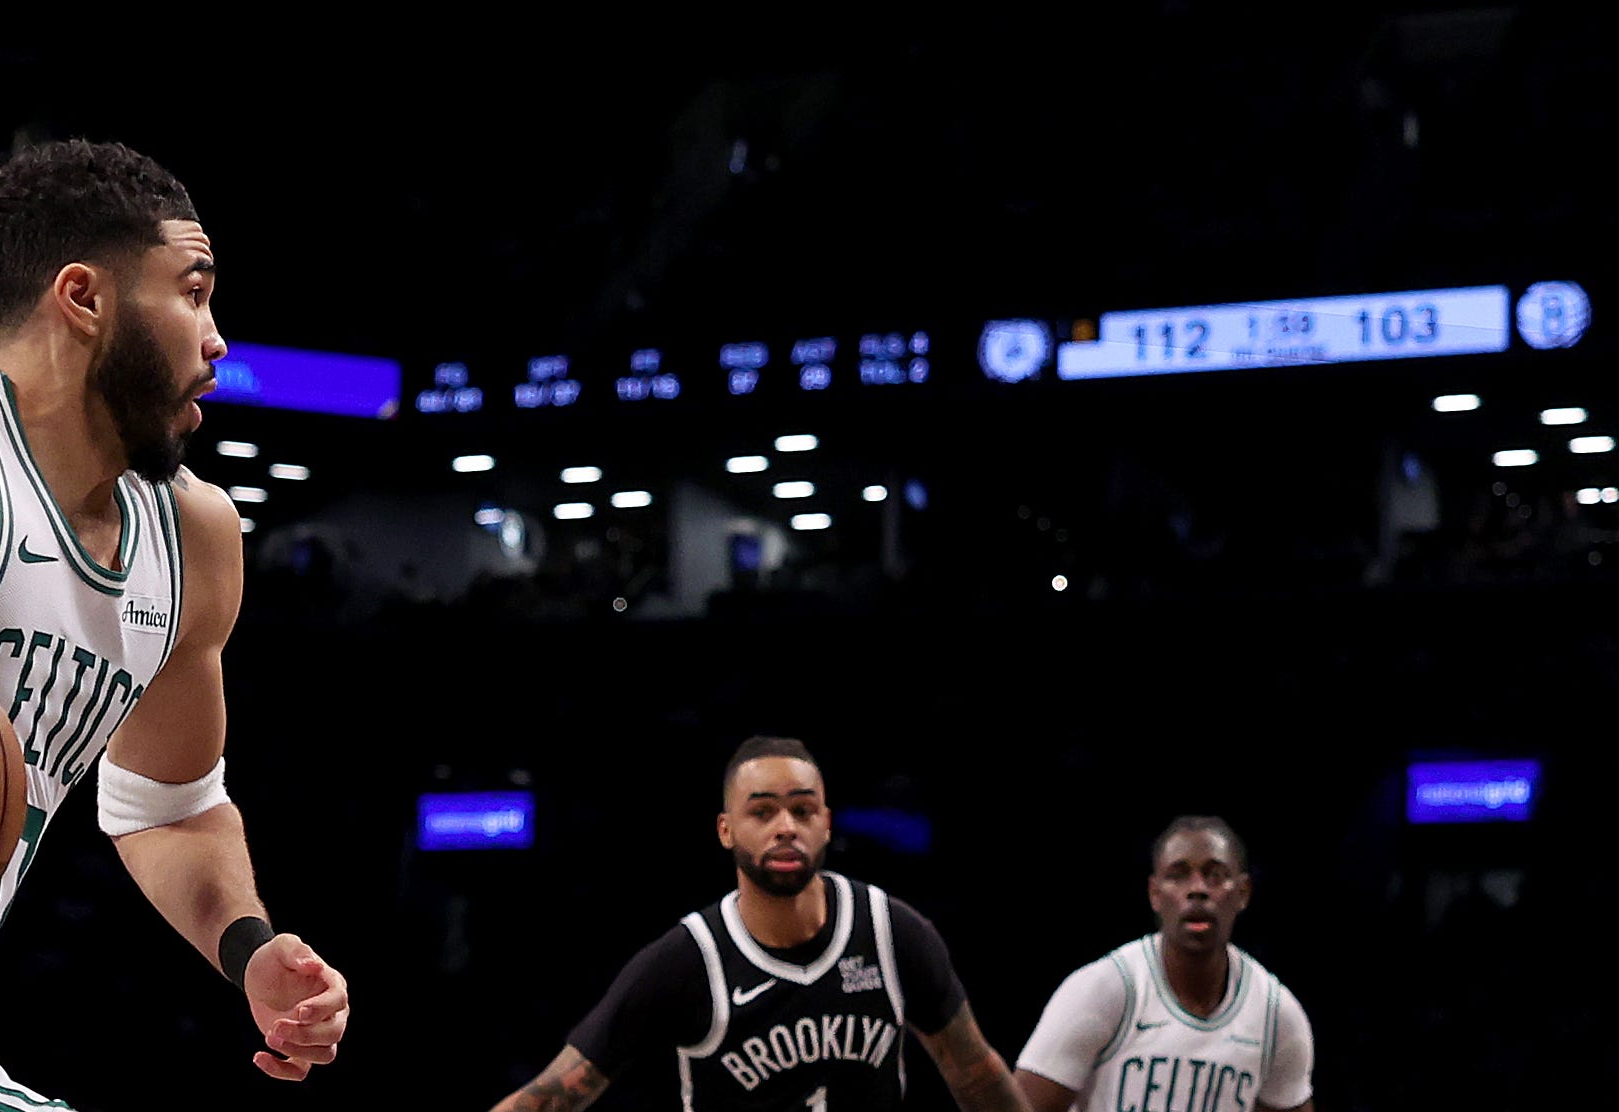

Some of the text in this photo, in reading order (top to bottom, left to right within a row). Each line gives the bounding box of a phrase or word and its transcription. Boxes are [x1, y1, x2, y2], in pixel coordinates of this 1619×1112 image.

[1134, 319, 1210, 361] 112
[1359, 305, 1437, 344] 103
[121, 600, 168, 629] Amica
[721, 1013, 897, 1091] BROOKLYN
